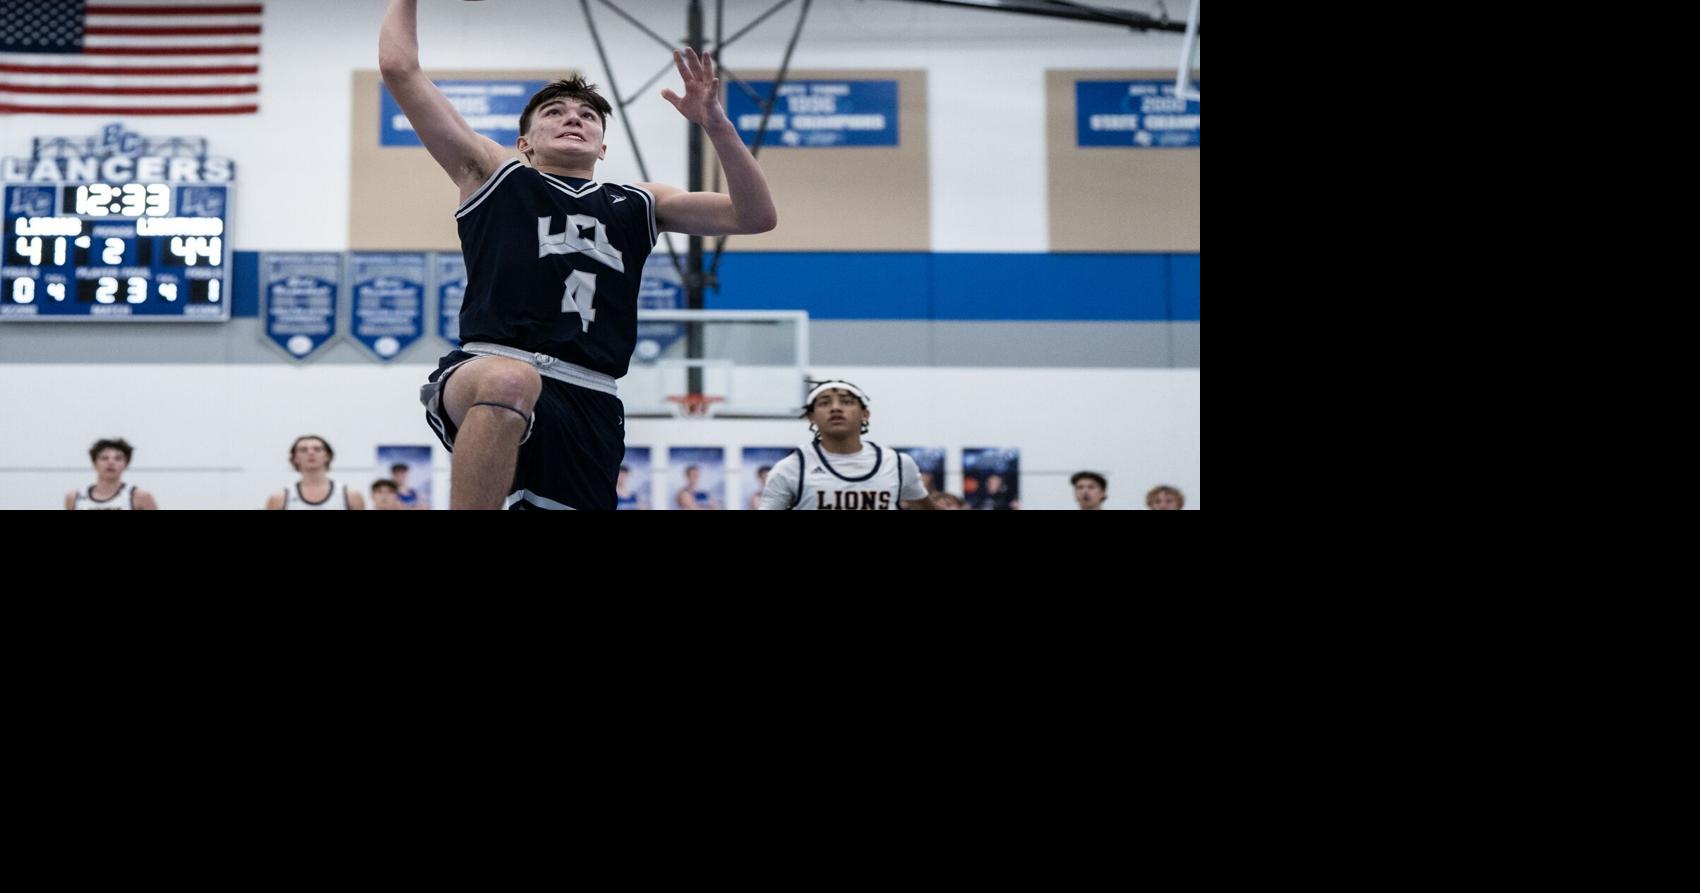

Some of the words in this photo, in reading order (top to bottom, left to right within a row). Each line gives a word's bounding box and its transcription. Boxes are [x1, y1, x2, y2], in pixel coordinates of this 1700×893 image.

[2, 156, 234, 182] LANCERS
[75, 183, 171, 217] 12:33
[16, 236, 67, 266] 41
[102, 237, 126, 265] 2
[170, 236, 222, 266] 44
[537, 213, 625, 274] LCL
[12, 276, 36, 304] 0
[561, 269, 597, 333] 4
[817, 490, 891, 510] LIONS
